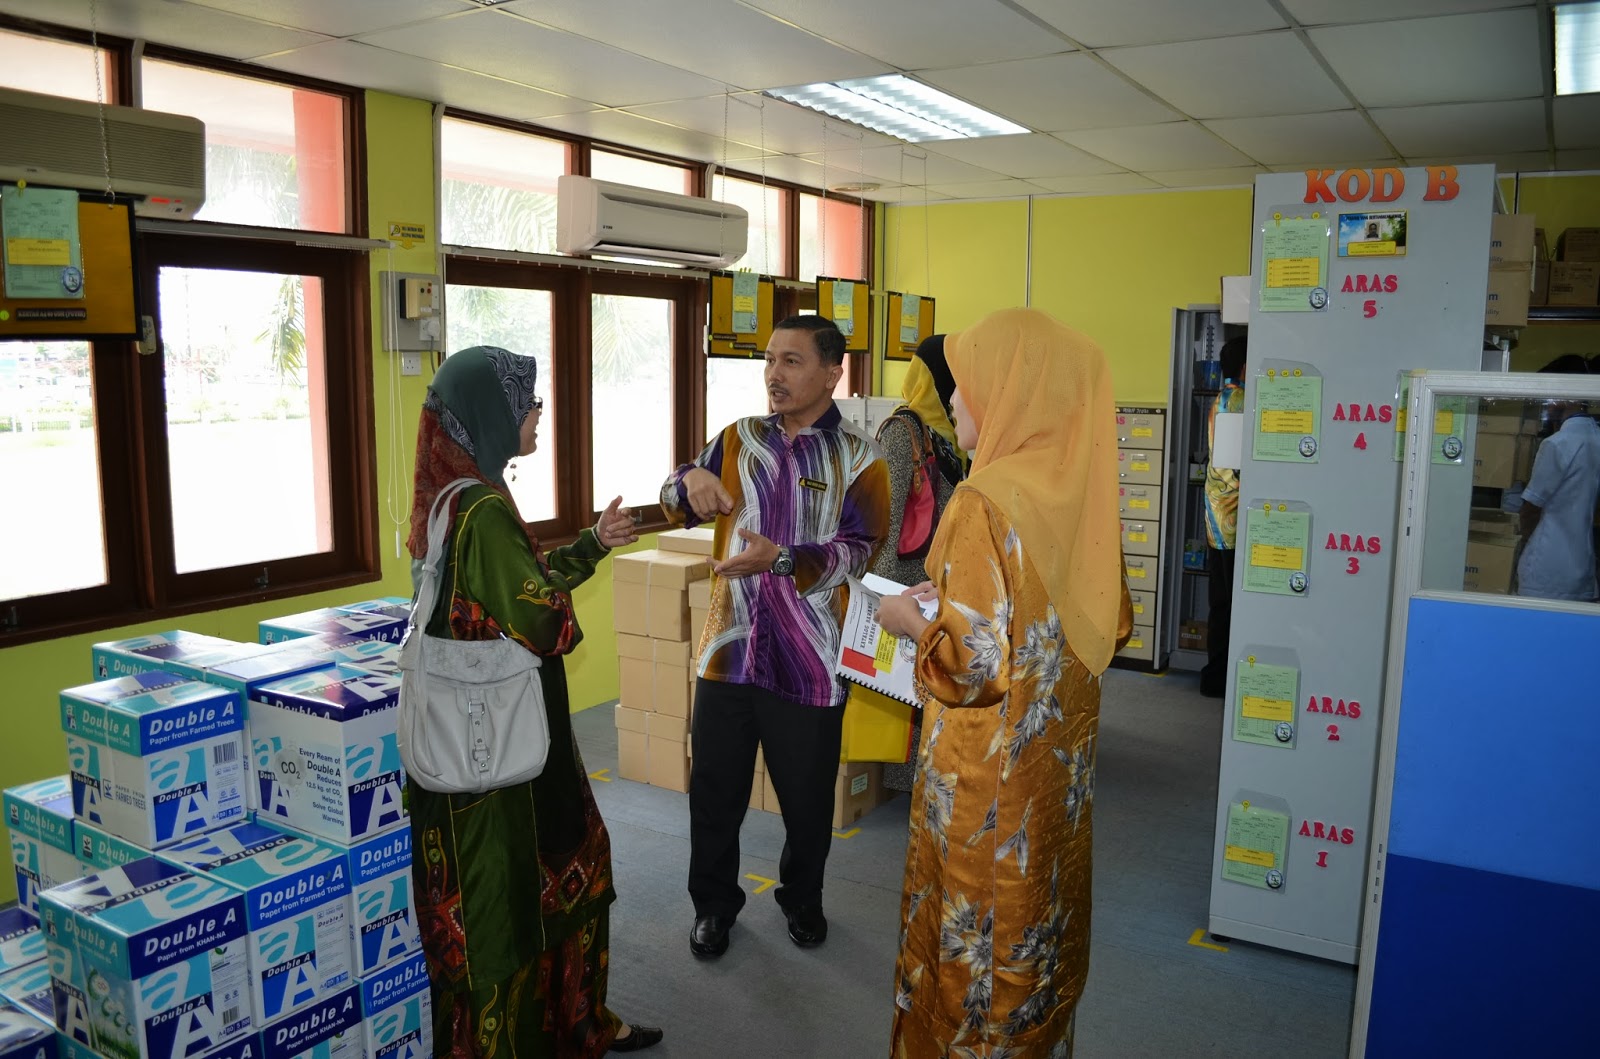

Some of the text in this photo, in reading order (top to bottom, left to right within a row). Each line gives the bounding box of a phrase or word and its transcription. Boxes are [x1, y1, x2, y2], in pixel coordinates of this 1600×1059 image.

[1303, 165, 1460, 203] KOD B
[1340, 274, 1398, 293] ARAS
[1363, 300, 1378, 319] 5
[1332, 403, 1393, 423] ARAS
[1353, 432, 1367, 450] 4
[1325, 532, 1381, 554] ARAS
[1345, 557, 1360, 575] 3
[150, 701, 234, 736] Double A
[1306, 696, 1361, 719] ARAS
[82, 710, 130, 738] Double A
[149, 718, 235, 746] Paper from Farmed Trees
[1326, 724, 1340, 741] 2
[299, 748, 315, 759] Every
[316, 752, 333, 762] Ream
[307, 760, 341, 777] Double A
[316, 774, 342, 787] Reduces
[158, 783, 202, 804] Double A
[353, 772, 396, 794] Double A
[312, 801, 344, 816] Solve Global
[321, 795, 336, 805] Helps
[24, 808, 65, 837] Double A
[322, 813, 345, 827] Warming
[1299, 820, 1354, 845] ARAS
[229, 838, 288, 862] Double
[360, 834, 412, 868] Doubl
[1315, 851, 1329, 868] 1
[361, 852, 412, 877] Paper from Farm
[115, 875, 182, 902] Double
[259, 864, 344, 910] Double A
[260, 882, 345, 920] Paper from Farmed Trees
[144, 919, 216, 957] Double
[223, 907, 236, 926] A
[318, 916, 339, 928] Double
[366, 915, 396, 933] Double
[398, 910, 404, 918] A
[65, 917, 106, 949] Double
[109, 941, 118, 957] A
[157, 930, 227, 963] Paper from KHAN-NA
[268, 959, 301, 978] Double
[304, 953, 311, 962] A
[372, 961, 427, 998] Double
[373, 974, 429, 1007] Paper from Farmed
[152, 995, 206, 1027] Double A
[276, 995, 353, 1046] Double A
[286, 1017, 345, 1050] Paper from KHAN-NA
[380, 1031, 417, 1057] Double A
